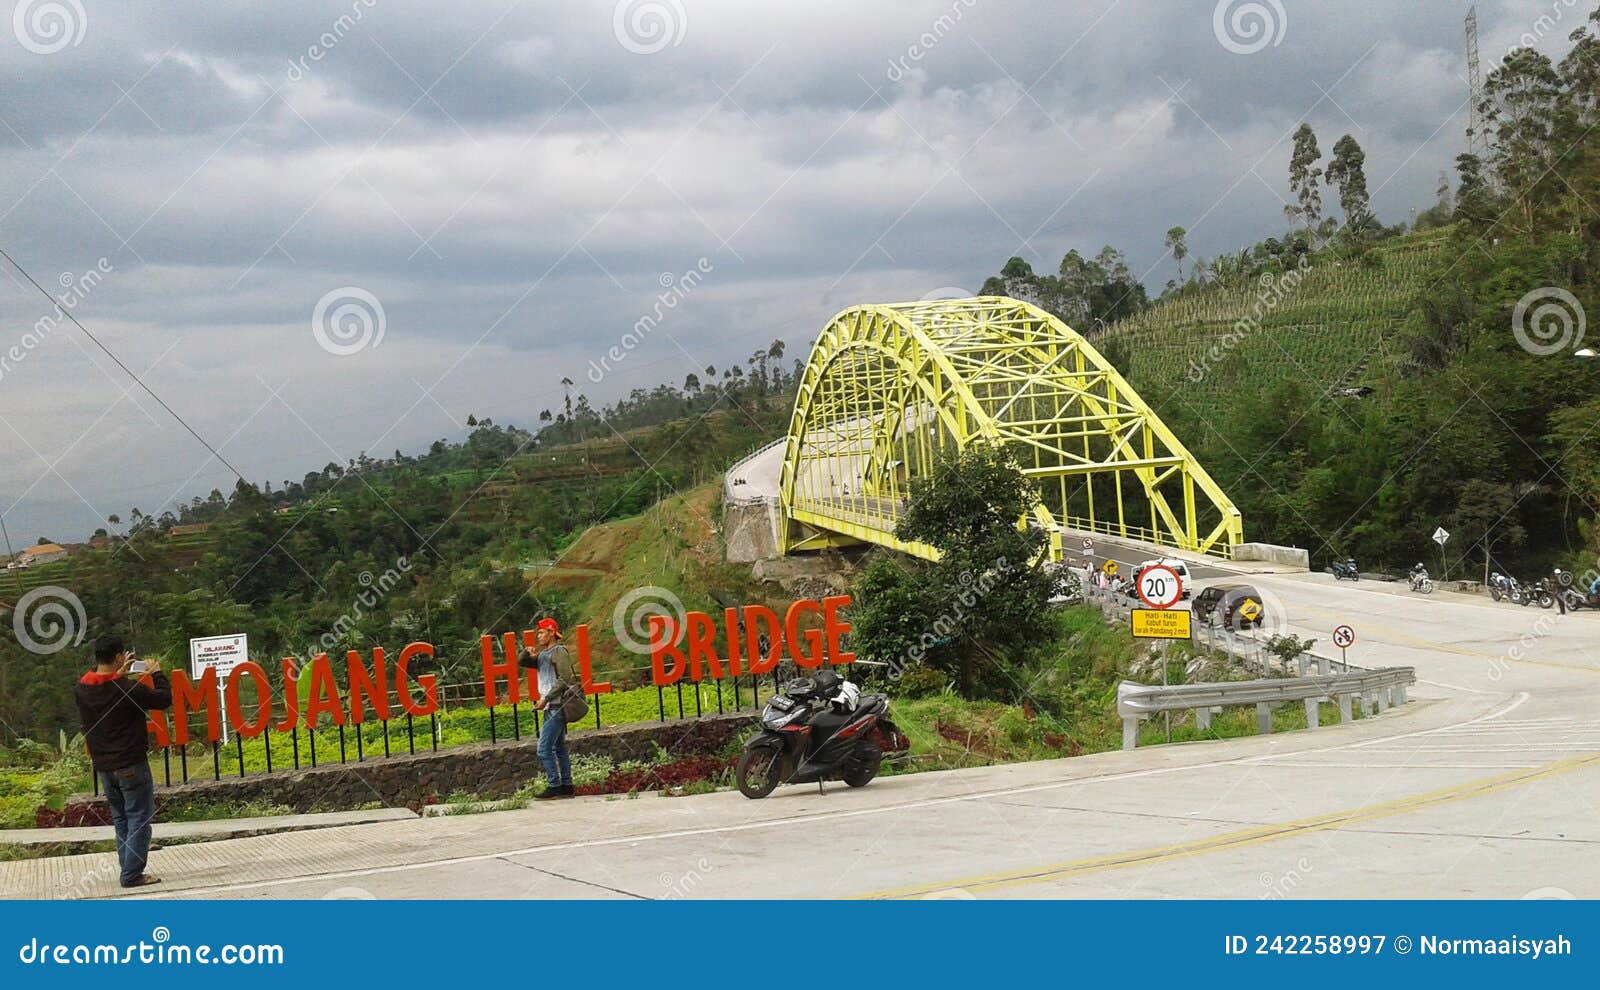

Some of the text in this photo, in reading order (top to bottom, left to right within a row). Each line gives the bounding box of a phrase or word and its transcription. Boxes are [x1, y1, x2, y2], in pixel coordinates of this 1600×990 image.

[1146, 578, 1165, 597] 20
[480, 624, 612, 706] HIL
[648, 595, 856, 687] BRIDGE
